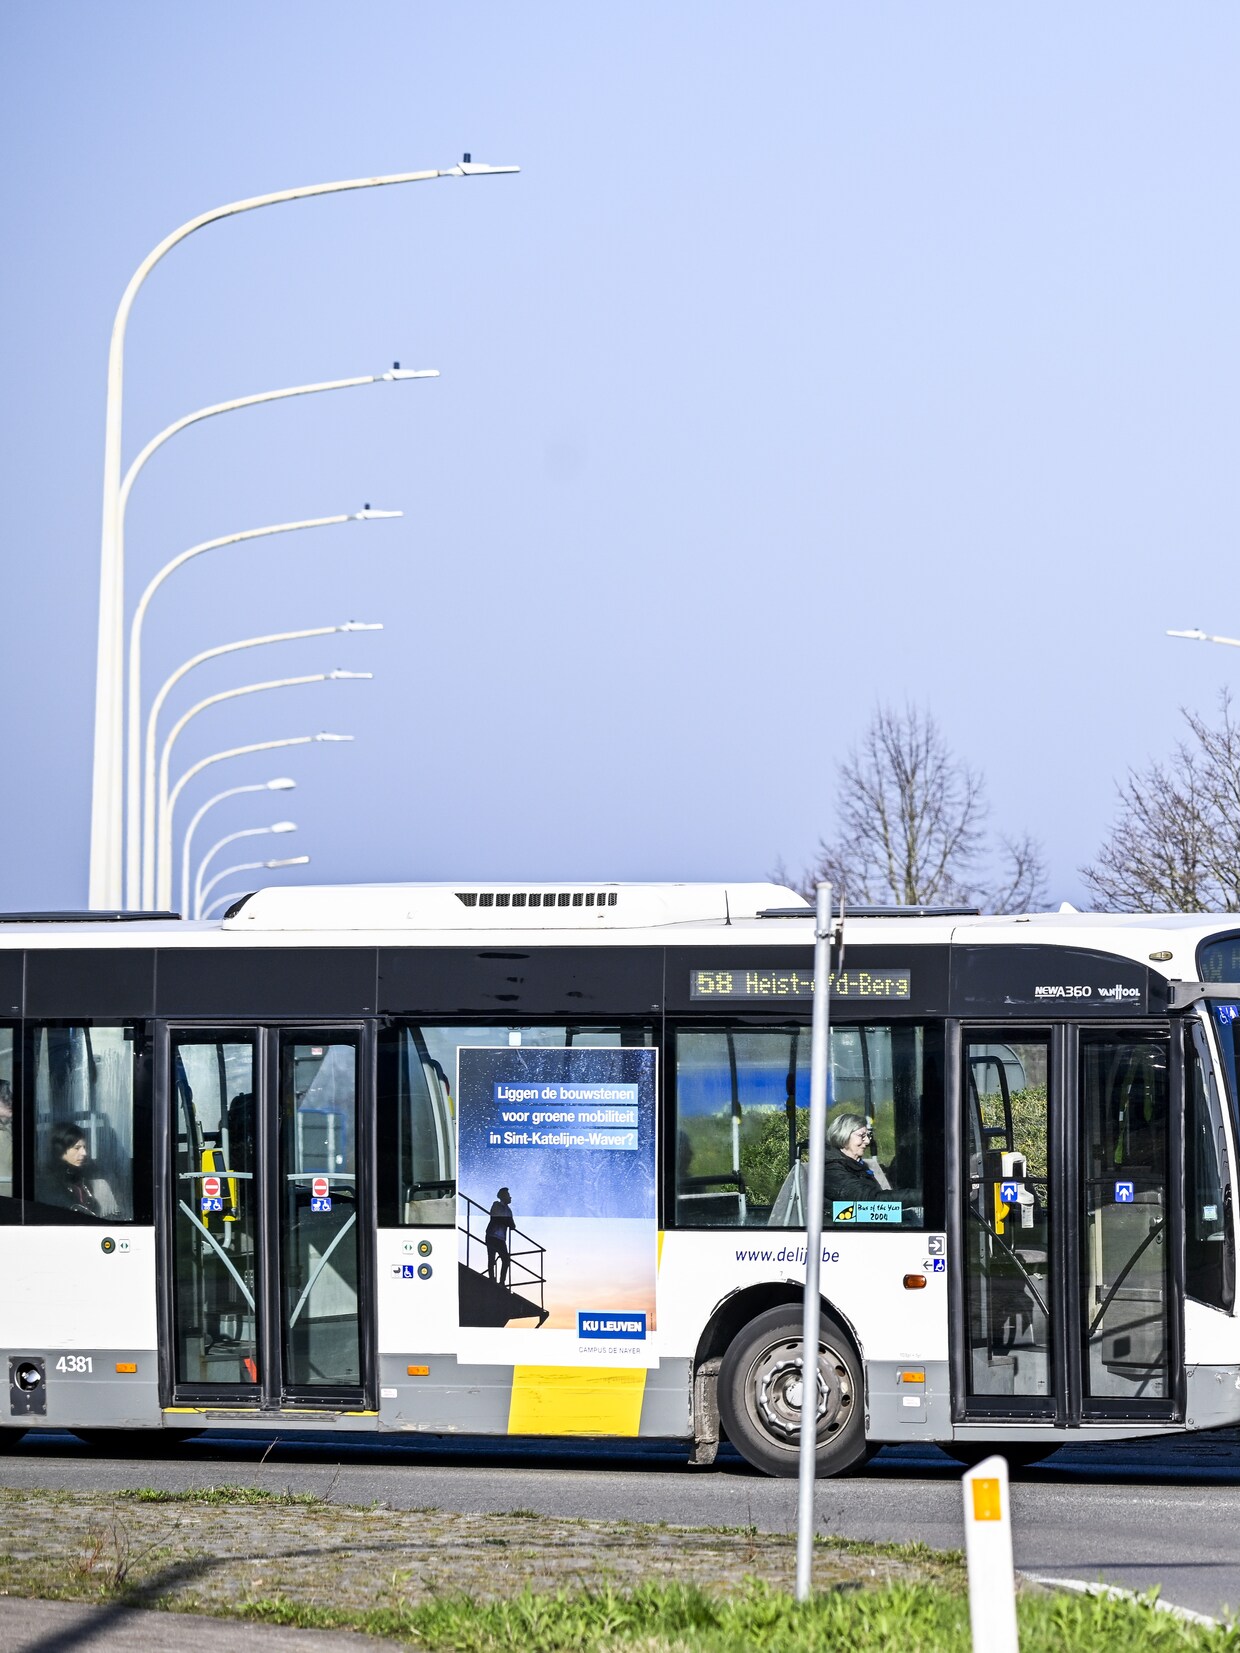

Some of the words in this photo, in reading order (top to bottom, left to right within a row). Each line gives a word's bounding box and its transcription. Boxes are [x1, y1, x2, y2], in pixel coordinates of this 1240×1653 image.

[698, 972, 733, 994] 58
[497, 1086, 539, 1101] Liggen
[541, 1087, 557, 1099] de
[560, 1087, 635, 1100] bouwstenen
[502, 1112, 529, 1122] voor
[532, 1112, 575, 1124] groene
[578, 1111, 635, 1123] mobiliteit
[489, 1132, 501, 1144] in
[503, 1132, 634, 1147] Sint-Katelijne-Waver?
[735, 1247, 840, 1265] www.delijbe
[582, 1320, 599, 1331] KU
[600, 1321, 642, 1332] LEUVEN
[55, 1355, 93, 1373] 4381
